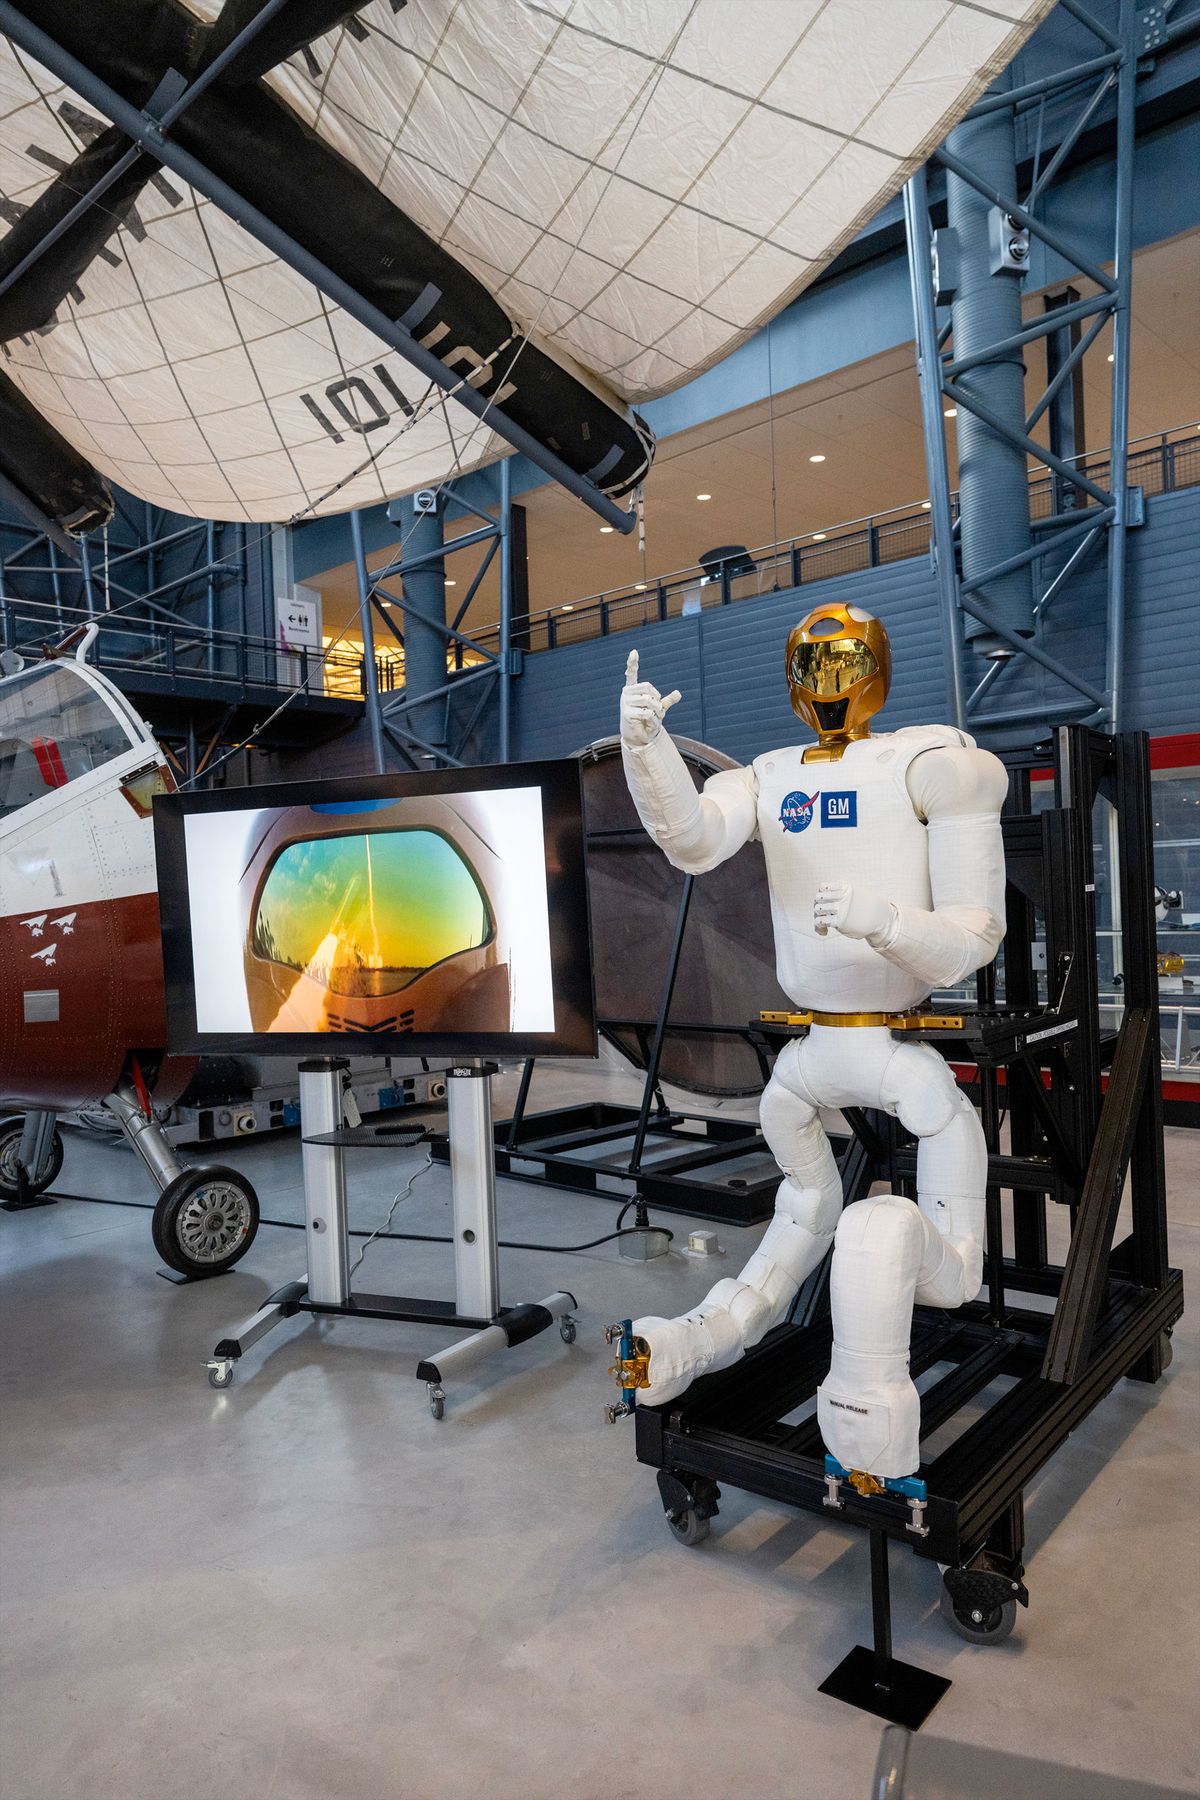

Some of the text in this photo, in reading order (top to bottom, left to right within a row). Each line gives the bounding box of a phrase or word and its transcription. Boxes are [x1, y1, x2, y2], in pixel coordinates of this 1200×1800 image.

[299, 363, 415, 444] 101
[782, 806, 811, 818] NASA
[828, 798, 849, 815] GM
[846, 1404, 868, 1415] RELEASE
